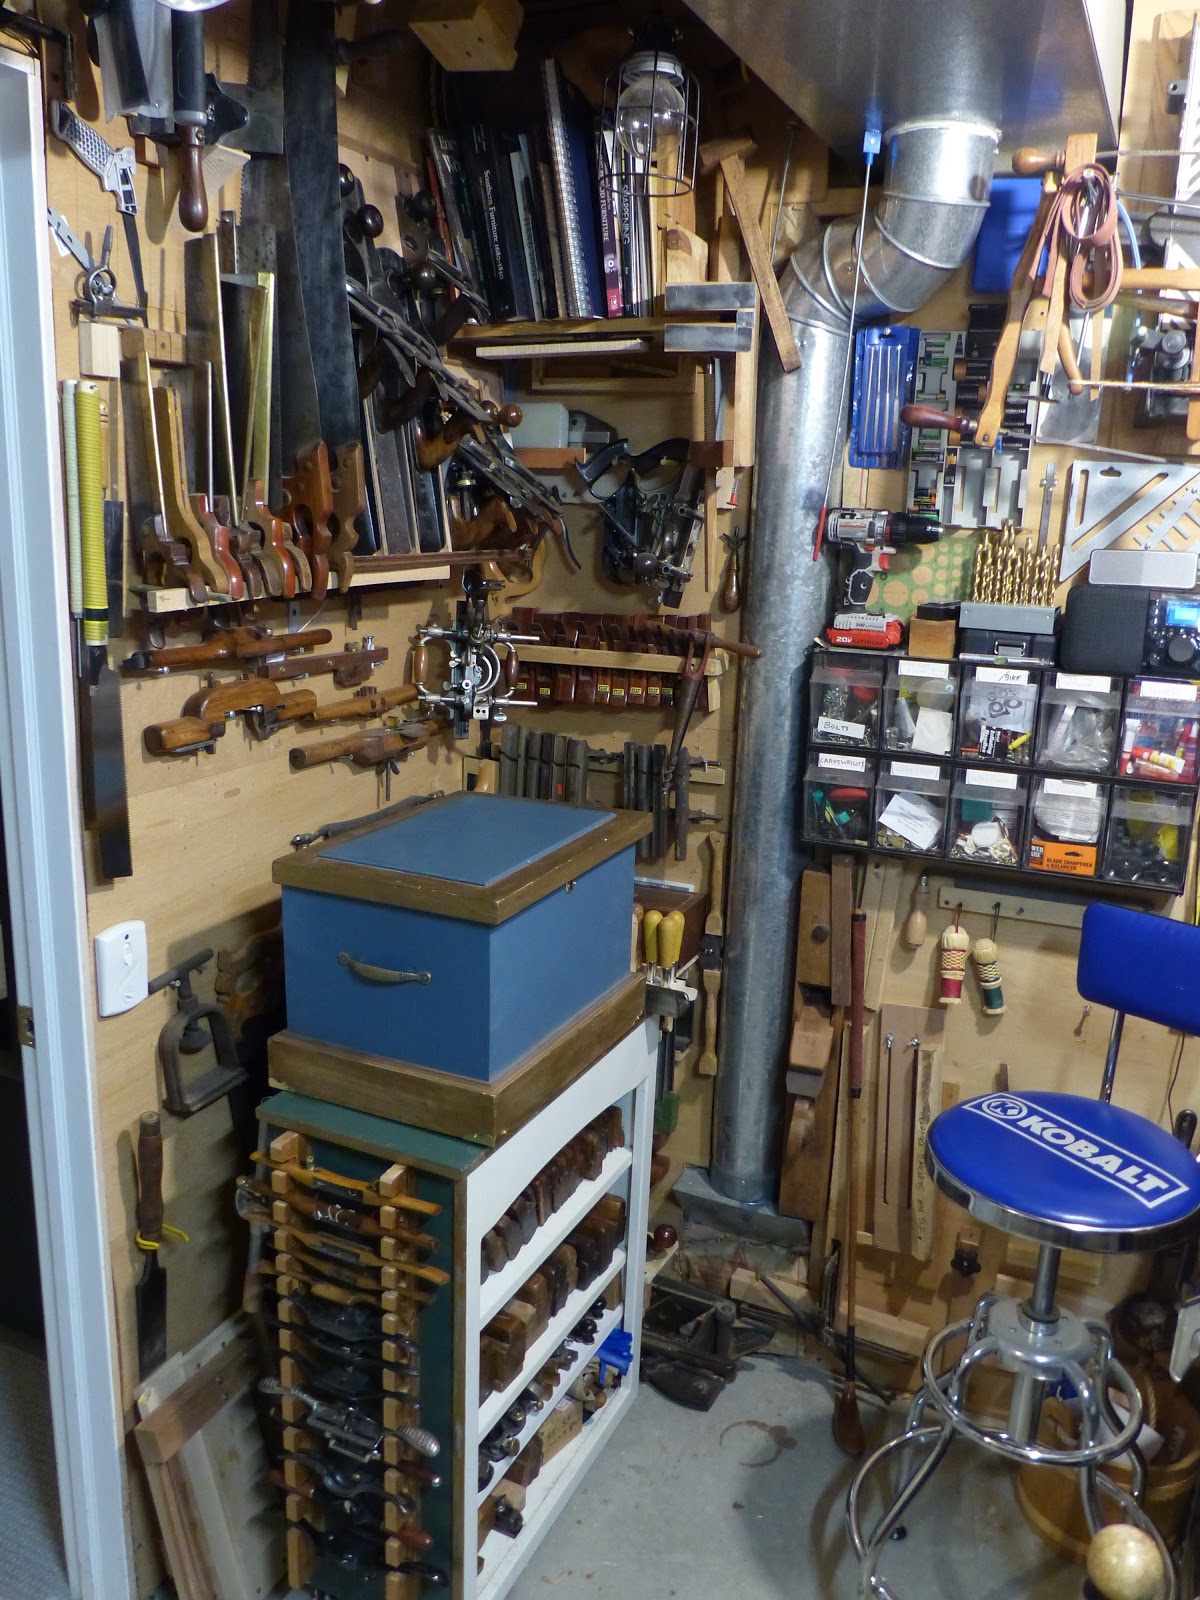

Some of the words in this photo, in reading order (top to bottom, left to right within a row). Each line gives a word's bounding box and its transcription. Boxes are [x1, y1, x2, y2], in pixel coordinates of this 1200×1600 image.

[483, 169, 493, 206] Southern
[488, 206, 499, 243] Furniture
[600, 199, 610, 243] FURNITURE
[824, 722, 848, 732] BOLTS
[820, 758, 864, 767] CARVEWRIGHT
[1016, 1114, 1168, 1194] KOBALT
